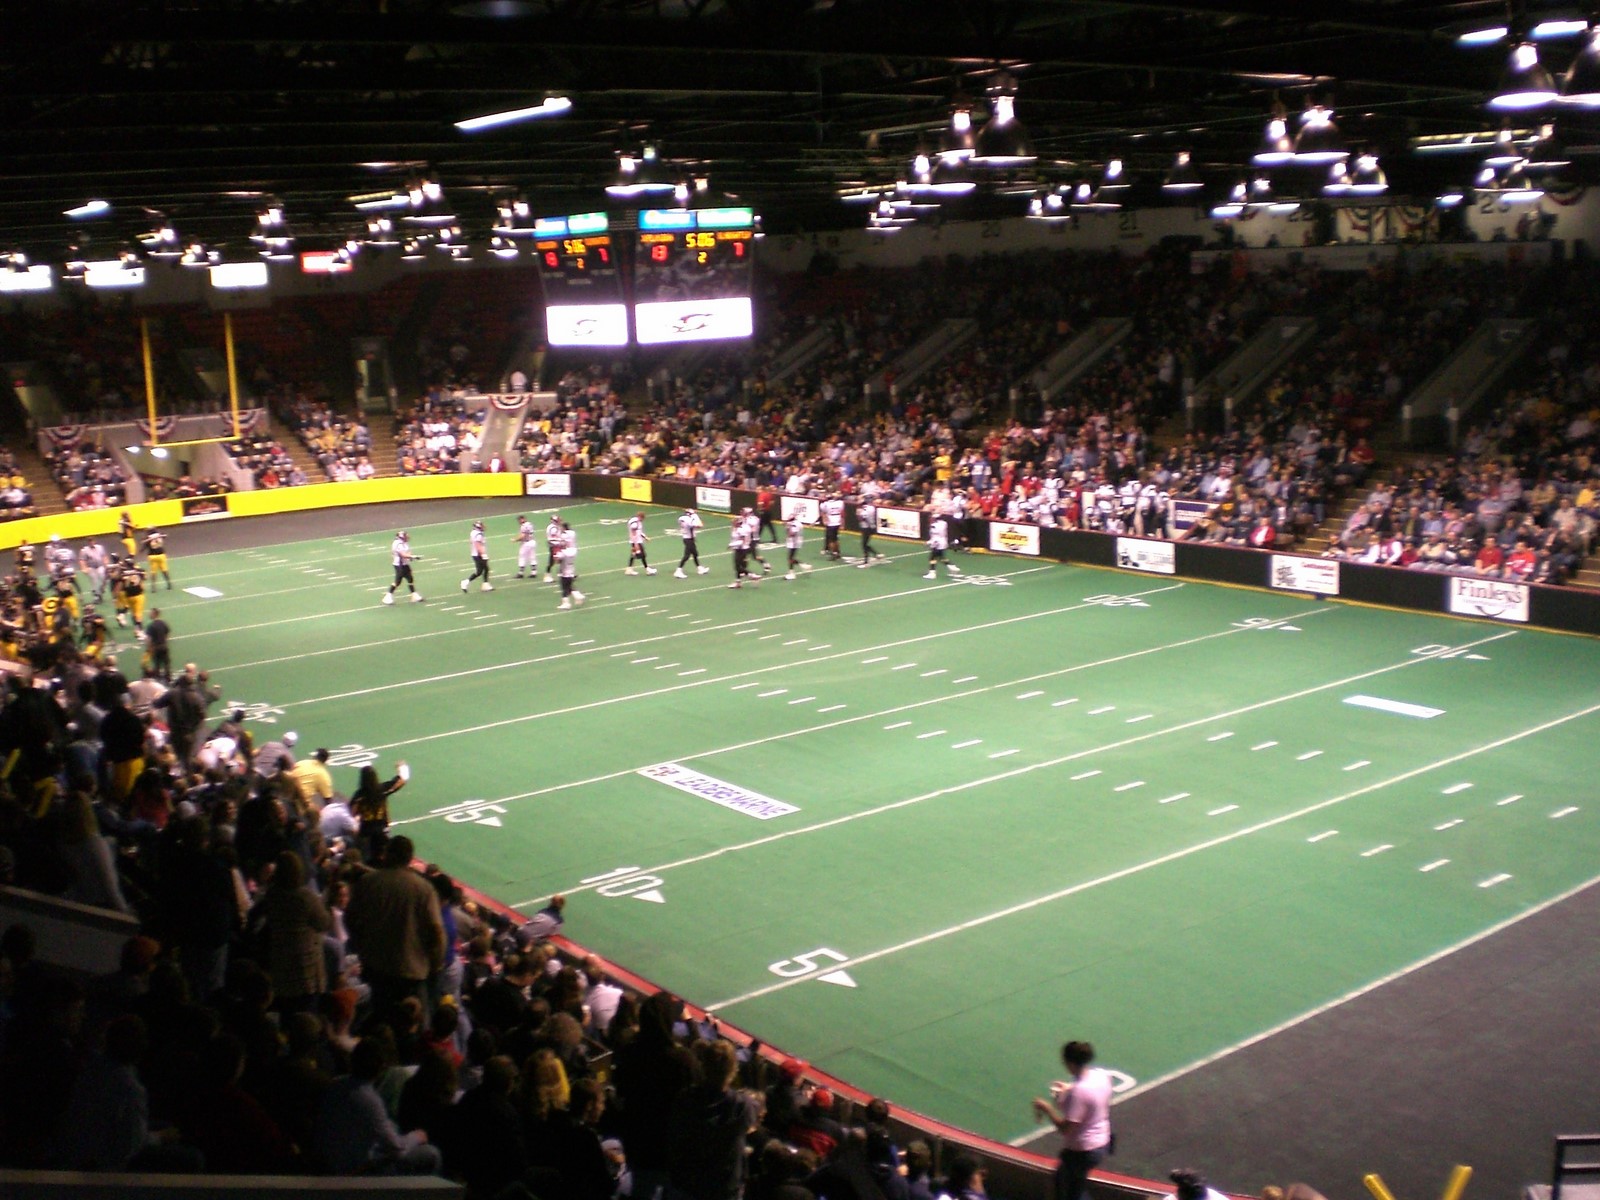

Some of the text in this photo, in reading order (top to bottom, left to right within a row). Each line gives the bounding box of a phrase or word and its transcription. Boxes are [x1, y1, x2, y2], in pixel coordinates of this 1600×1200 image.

[429, 799, 508, 823] 15
[580, 867, 664, 897] 10
[768, 947, 849, 977] 5
